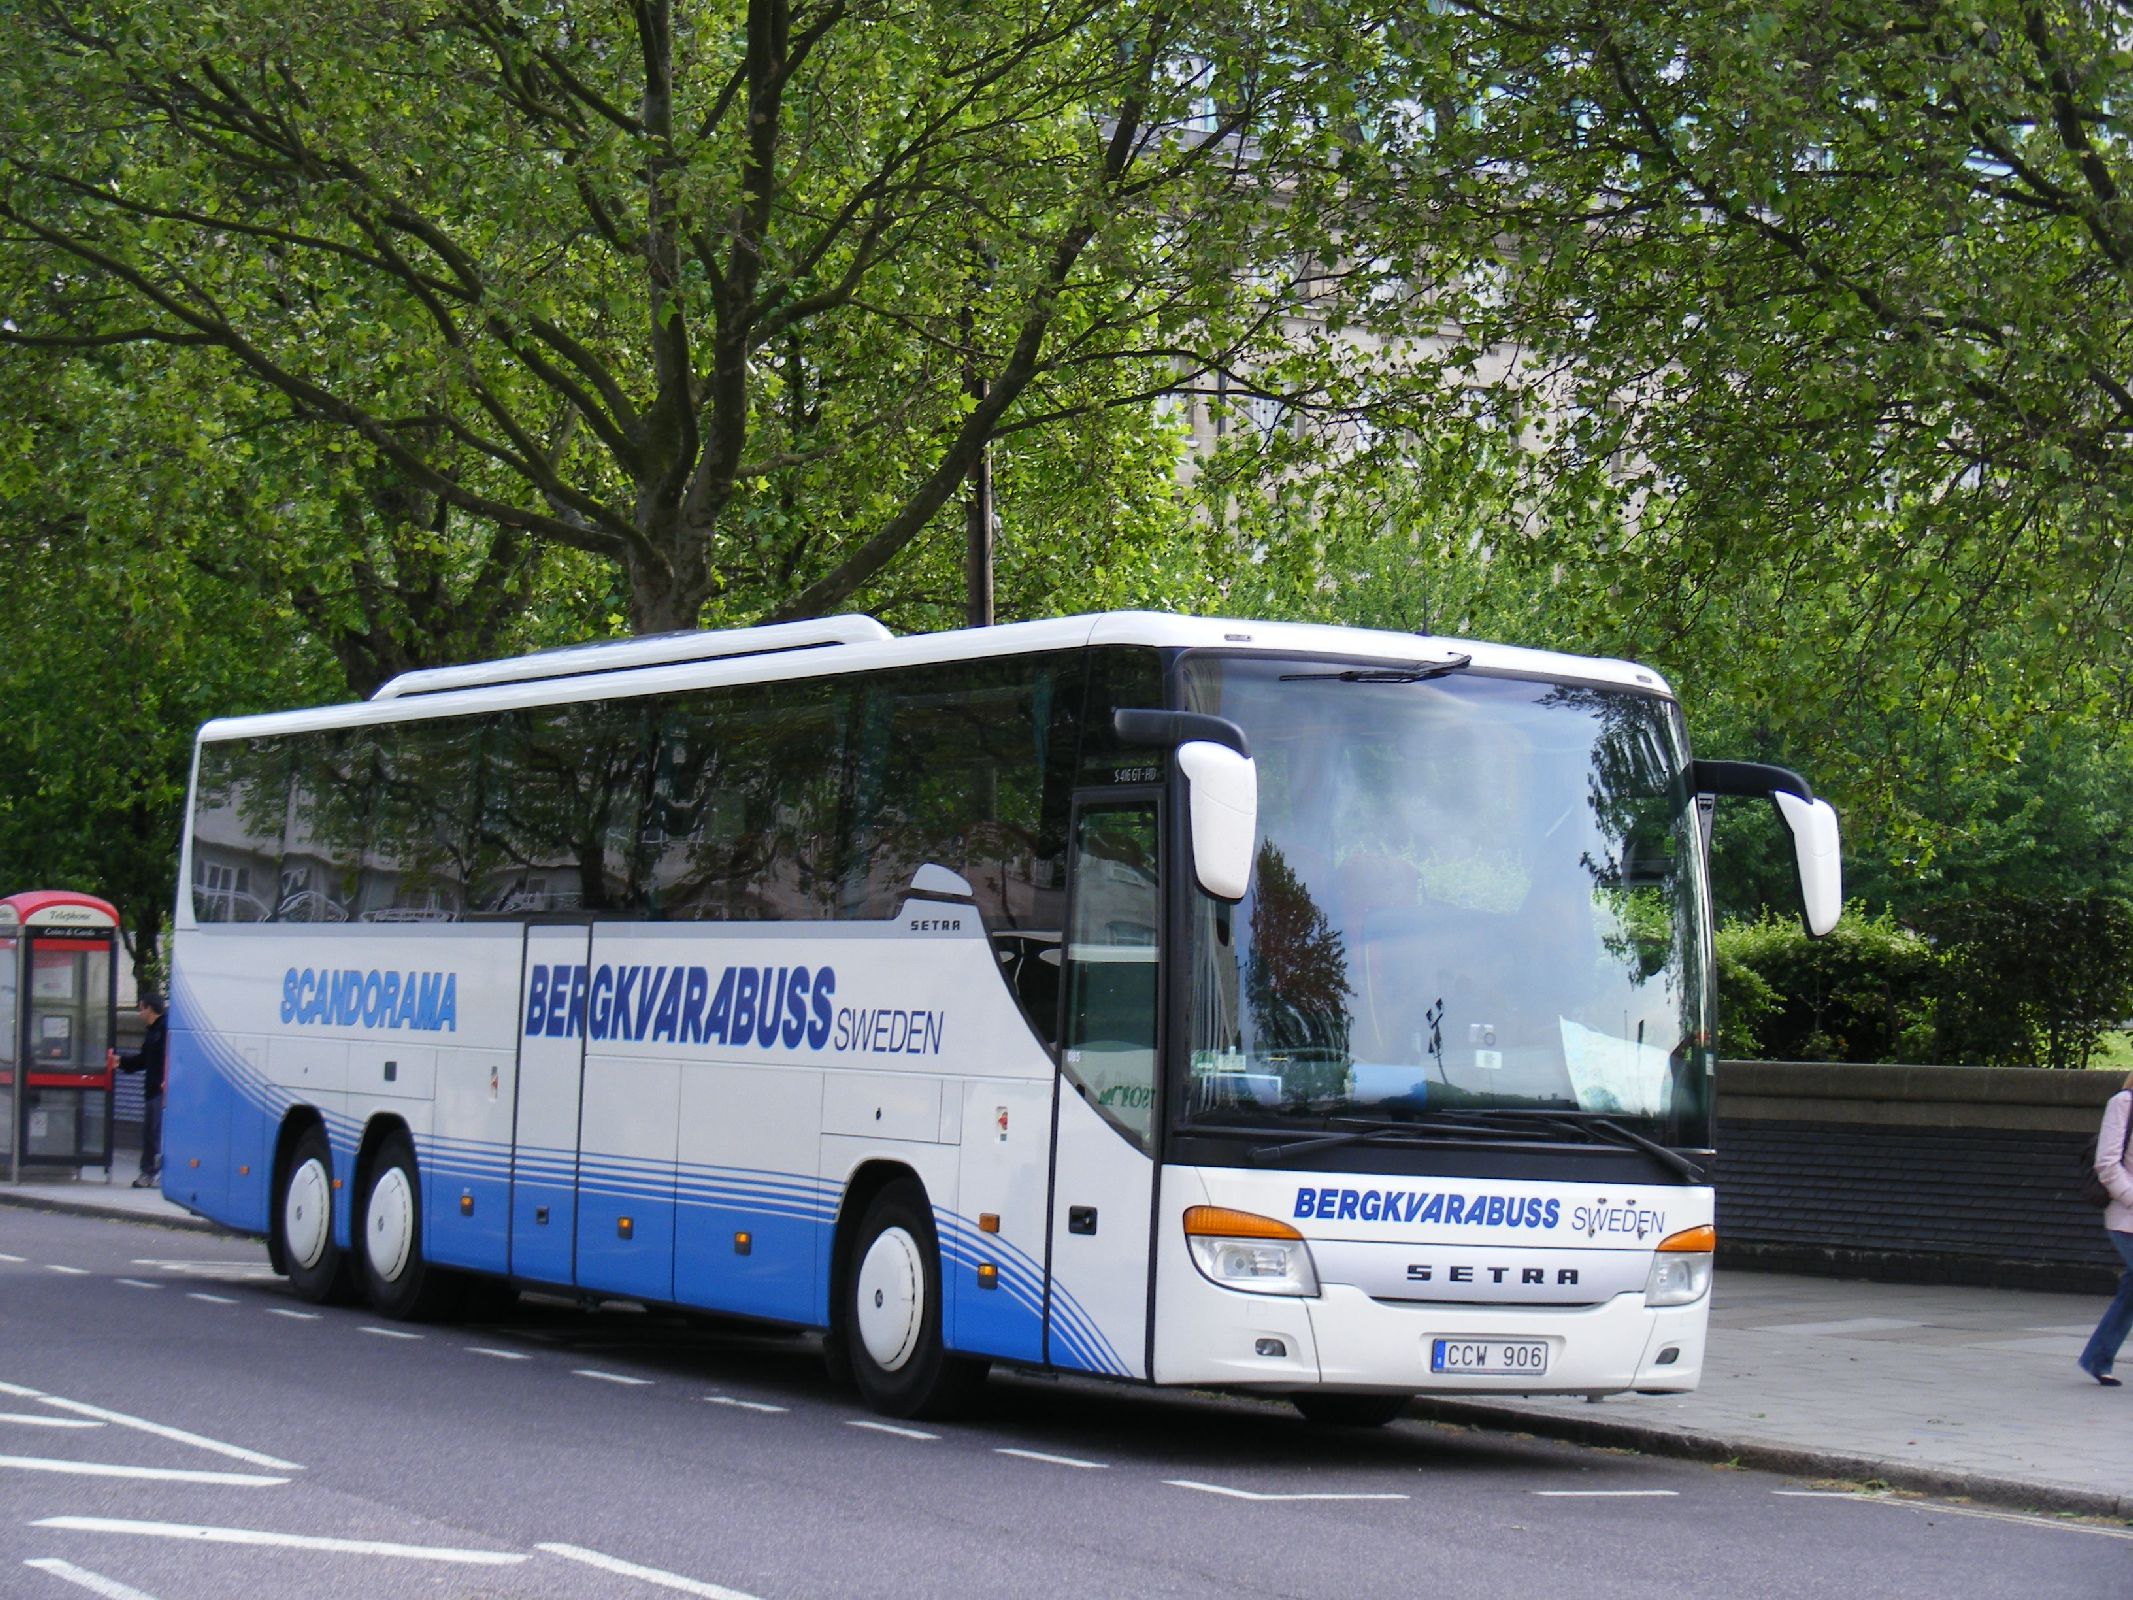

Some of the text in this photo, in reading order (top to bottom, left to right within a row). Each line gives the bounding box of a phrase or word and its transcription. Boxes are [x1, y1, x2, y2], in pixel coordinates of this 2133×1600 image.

[50, 910, 91, 920] Telephone
[910, 920, 961, 931] SETRA
[281, 967, 457, 1031] SCANDORAMA
[525, 964, 943, 1054] BERGKVARABUSS SWEDEN
[1294, 1188, 1664, 1233] BERGKVARABUSS SWEDEN
[1407, 1265, 1579, 1285] SETRA
[1448, 1345, 1542, 1367] CCW 906
